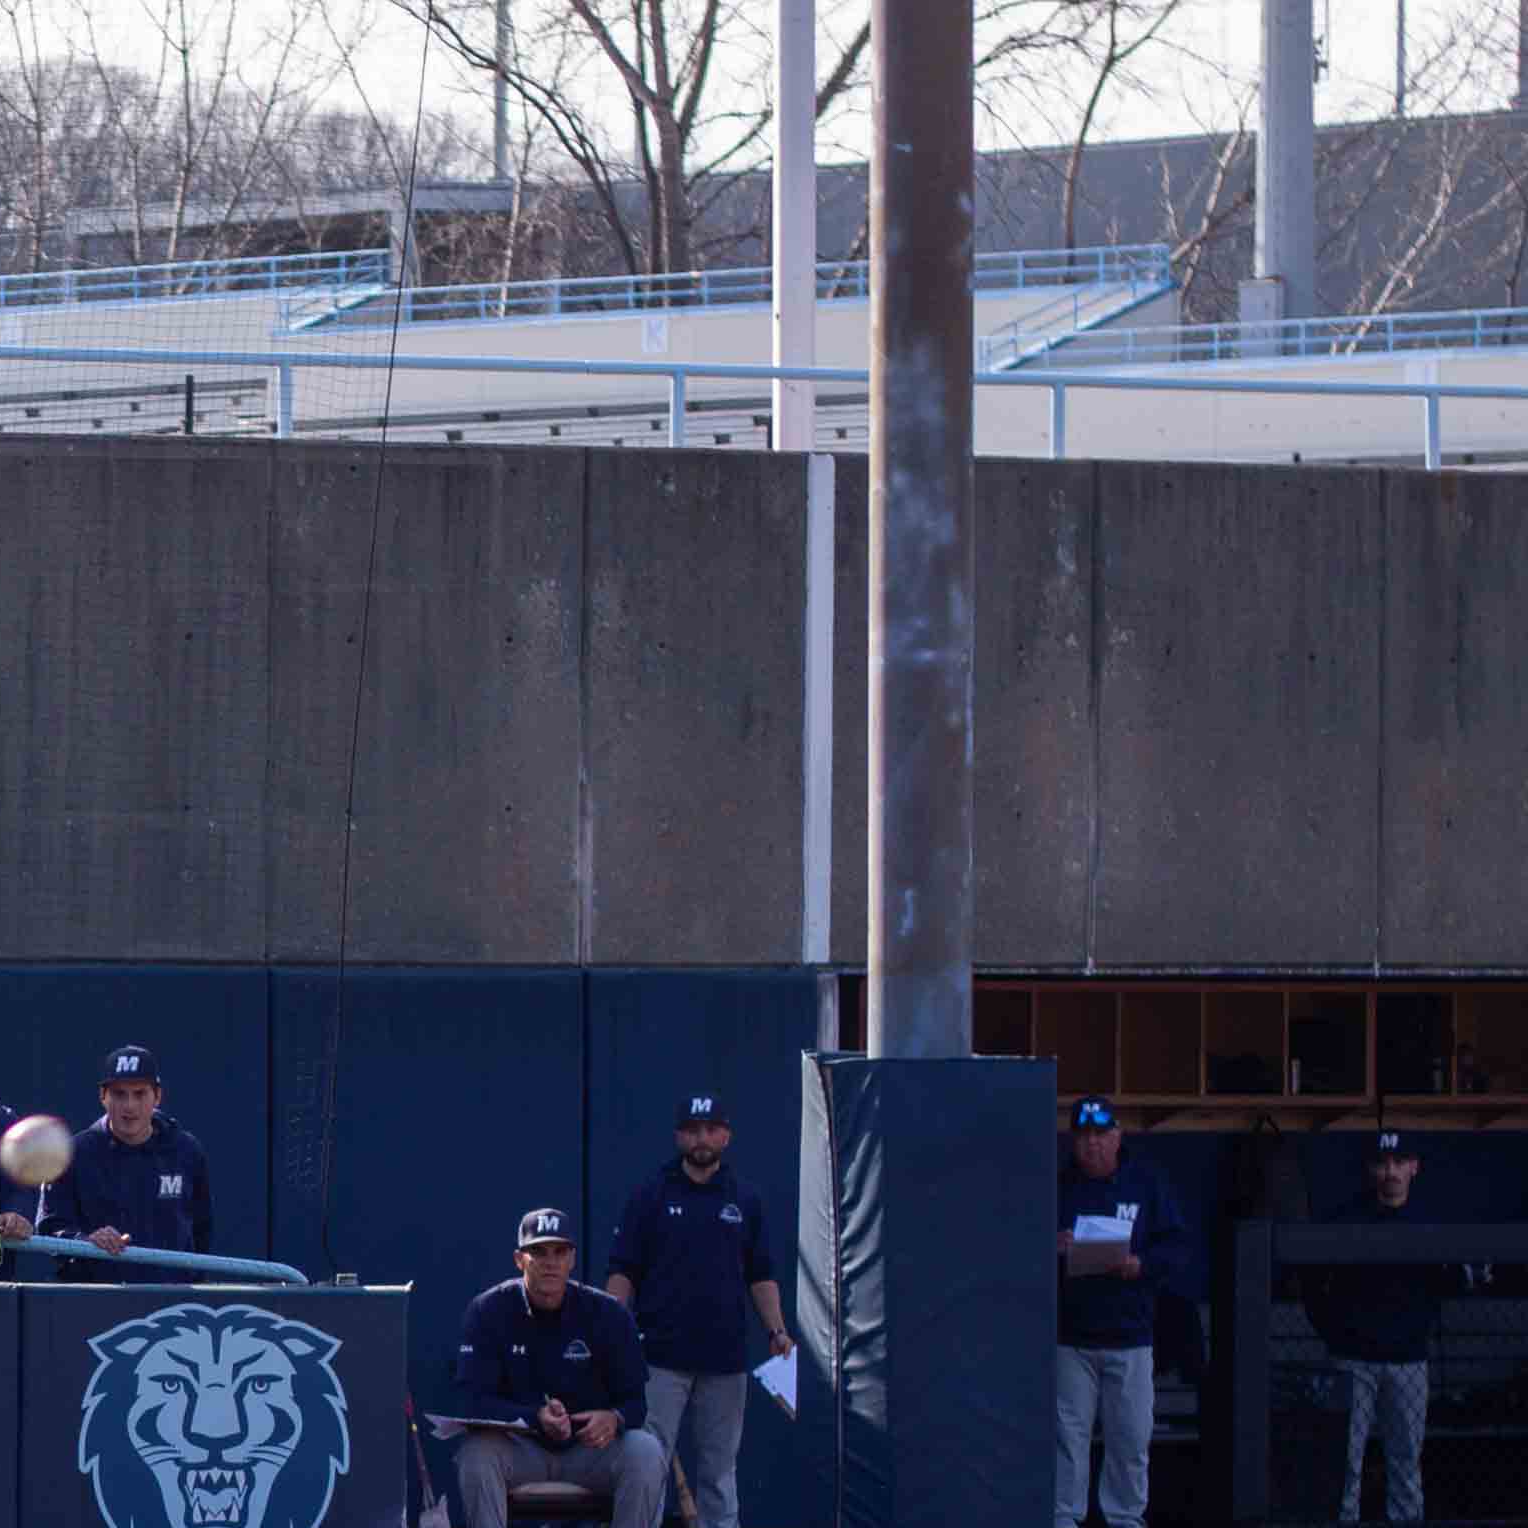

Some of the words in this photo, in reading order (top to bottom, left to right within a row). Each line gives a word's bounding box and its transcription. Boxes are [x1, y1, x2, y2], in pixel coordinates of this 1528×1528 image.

[115, 1055, 140, 1073] M
[689, 1097, 713, 1115] M
[159, 1175, 183, 1195] M
[1116, 1203, 1140, 1221] M
[537, 1215, 561, 1233] M
